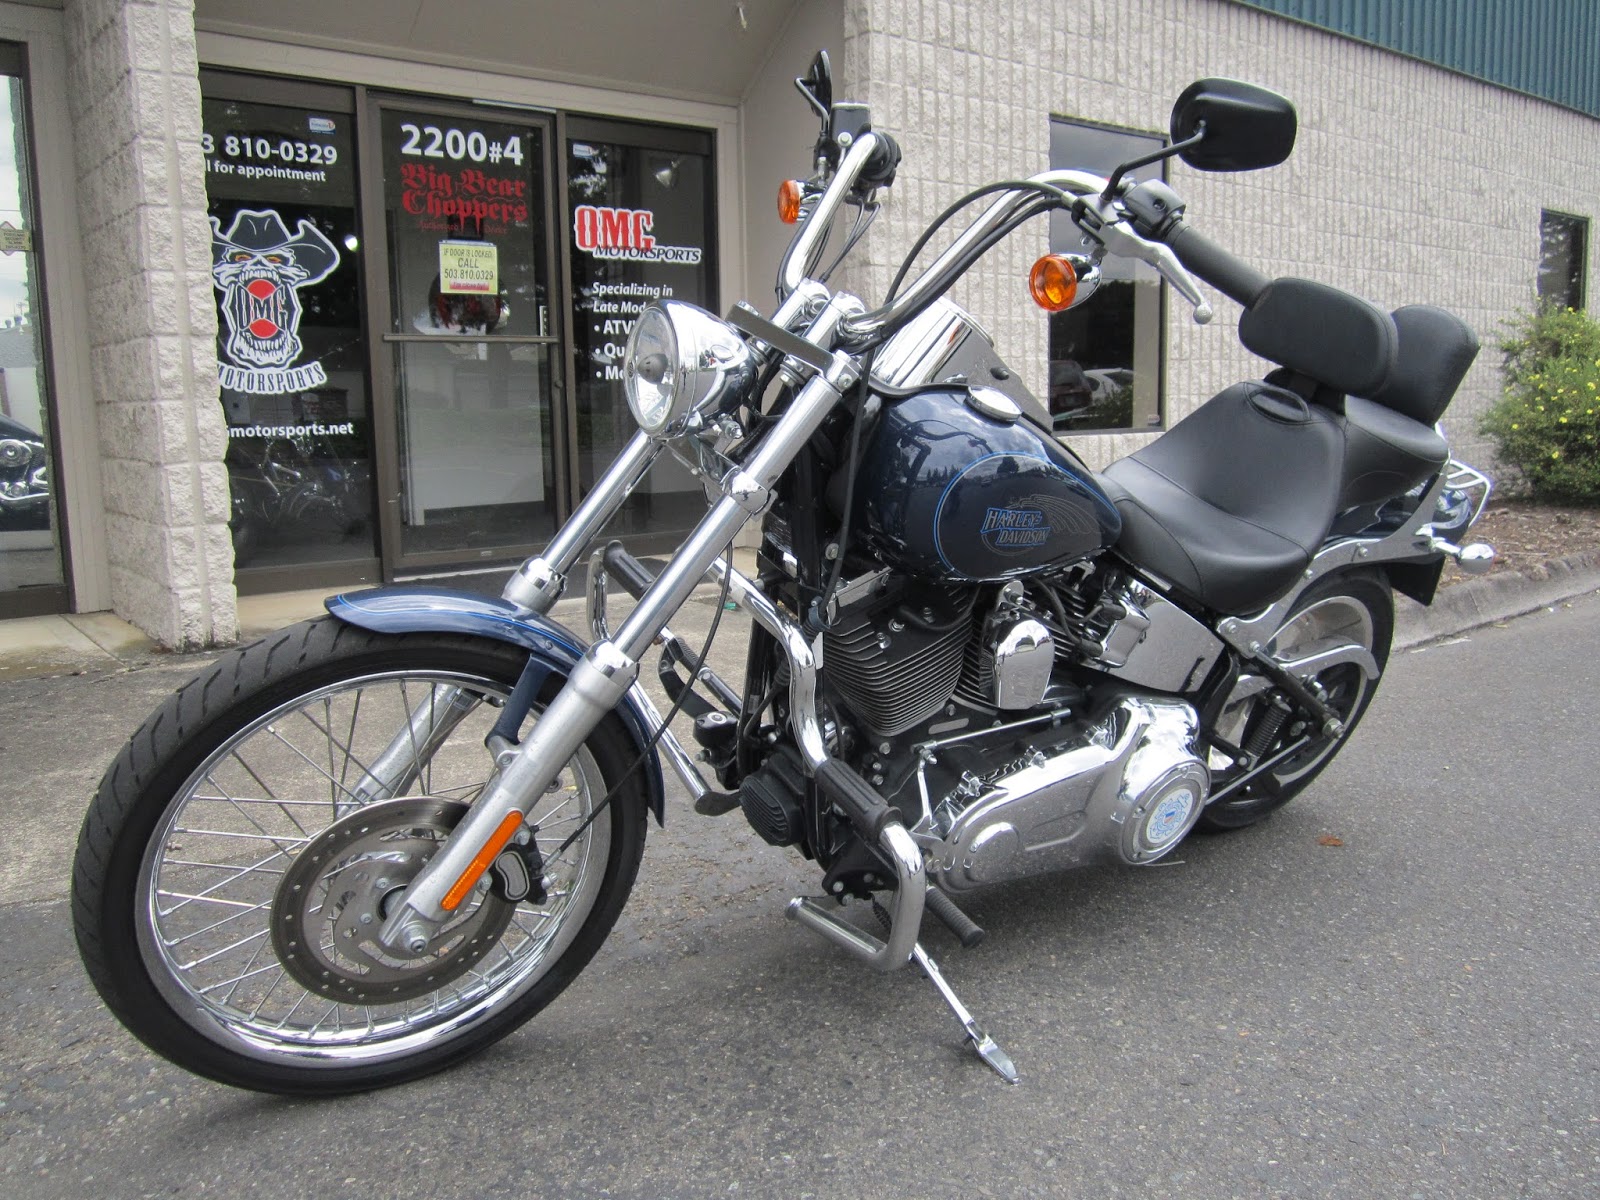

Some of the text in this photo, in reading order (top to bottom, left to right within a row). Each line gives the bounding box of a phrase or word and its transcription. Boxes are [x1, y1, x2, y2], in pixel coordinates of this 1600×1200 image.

[225, 136, 338, 165] 810-0329
[401, 124, 524, 166] 2200#4
[214, 161, 233, 174] for
[237, 164, 326, 182] appointment
[401, 163, 526, 198] Big Bear
[402, 189, 528, 232] Choppers
[574, 205, 655, 251] OMG
[450, 248, 465, 257] DOOR
[594, 244, 700, 263] MOTORSPORTS
[457, 258, 479, 269] CALL
[444, 269, 494, 280] 503.810.0329
[592, 281, 673, 299] Specializing in
[236, 283, 288, 333] OMG
[592, 301, 646, 314] Late Mod
[226, 423, 354, 438] motorsports.net
[998, 529, 1049, 544] DAVIDSON
